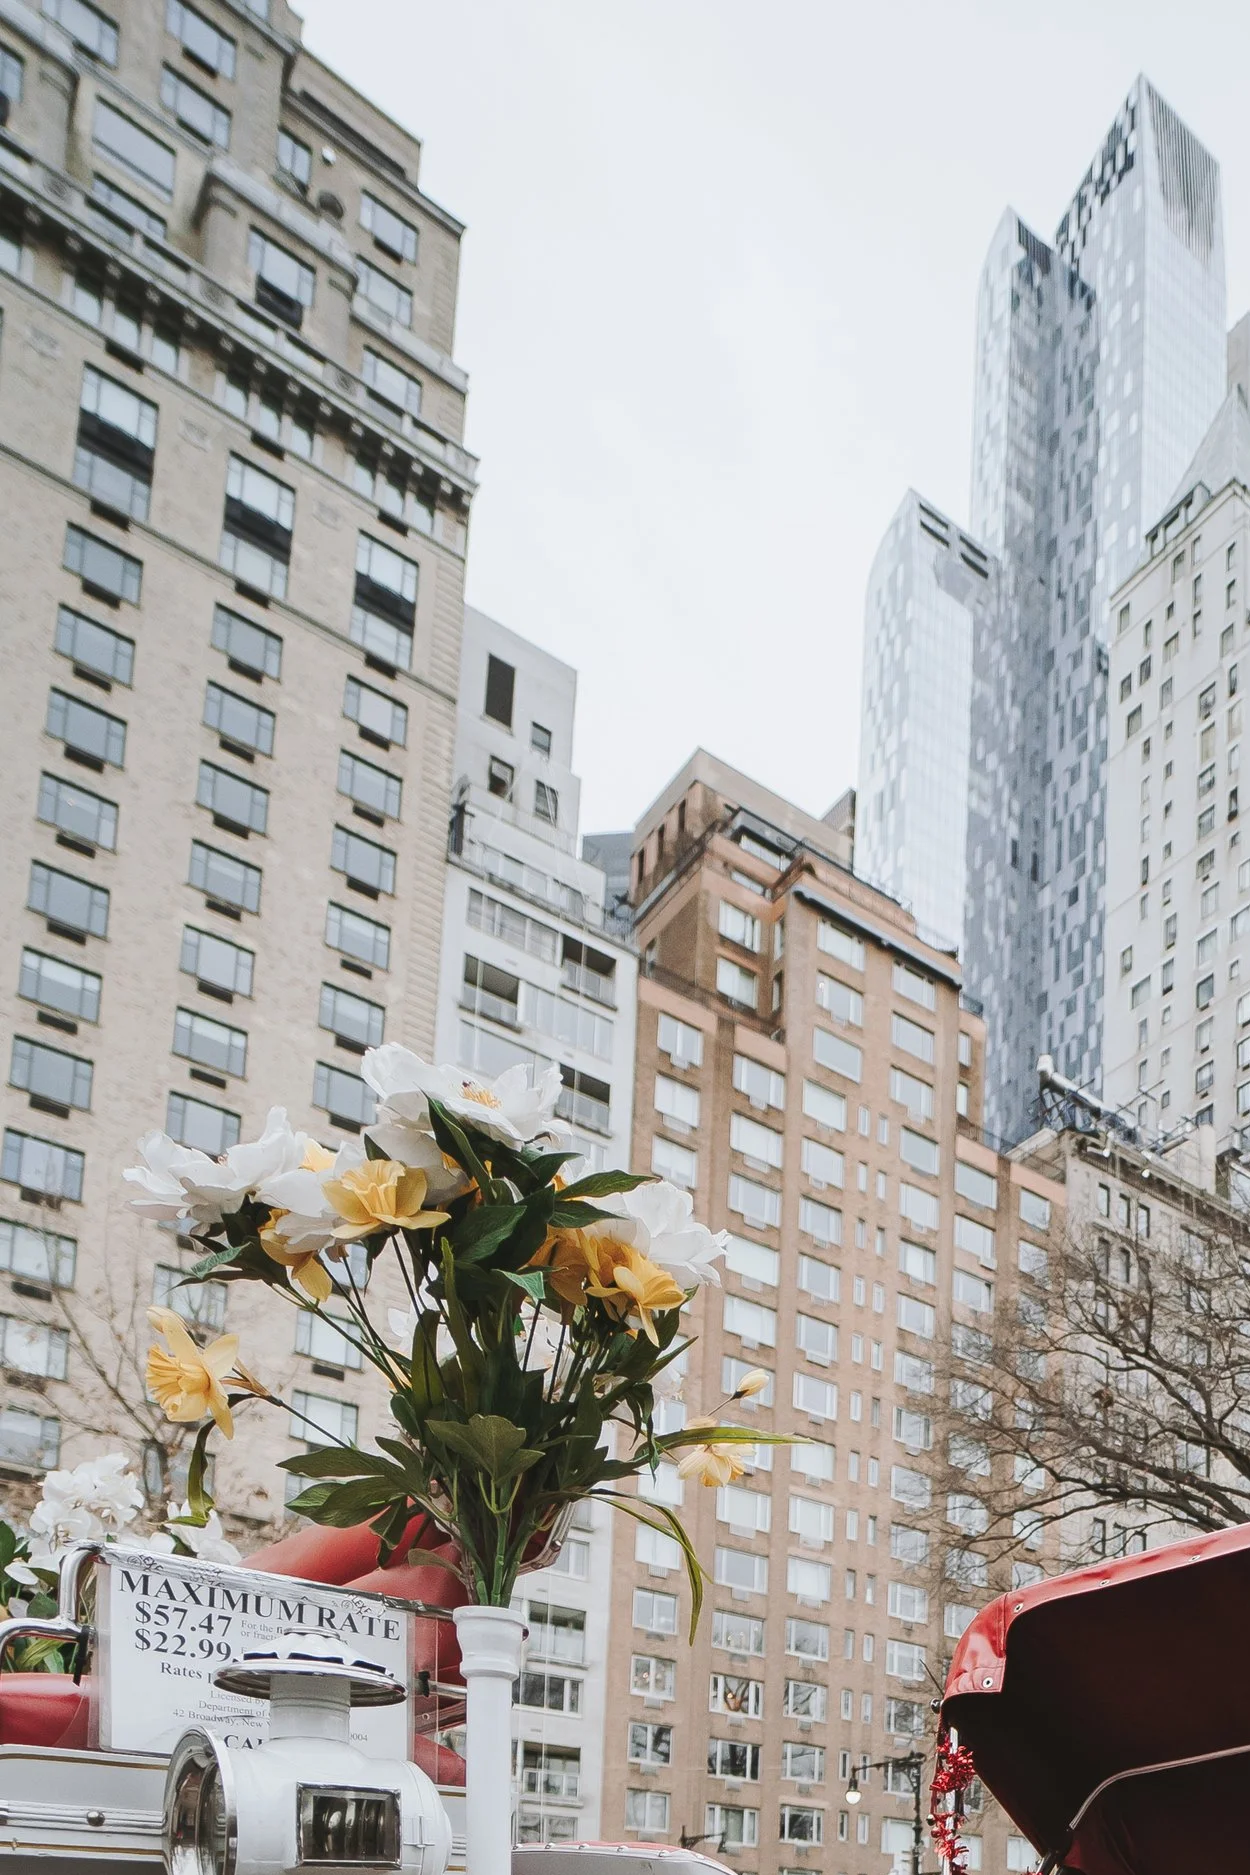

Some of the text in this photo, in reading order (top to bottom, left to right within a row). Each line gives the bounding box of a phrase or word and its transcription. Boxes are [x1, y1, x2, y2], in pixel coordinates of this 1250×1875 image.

[119, 1569, 306, 1624] MAXIMUM
[316, 1606, 400, 1641] RATE
[135, 1601, 233, 1637] $57.47
[241, 1620, 259, 1630] For
[260, 1622, 274, 1632] the
[241, 1630, 250, 1638] or
[134, 1628, 232, 1663] $22.99
[160, 1661, 202, 1679] Rates
[210, 1690, 266, 1707] Licensed by
[199, 1700, 266, 1717] Department of
[172, 1708, 185, 1718] 42
[242, 1718, 262, 1728] New
